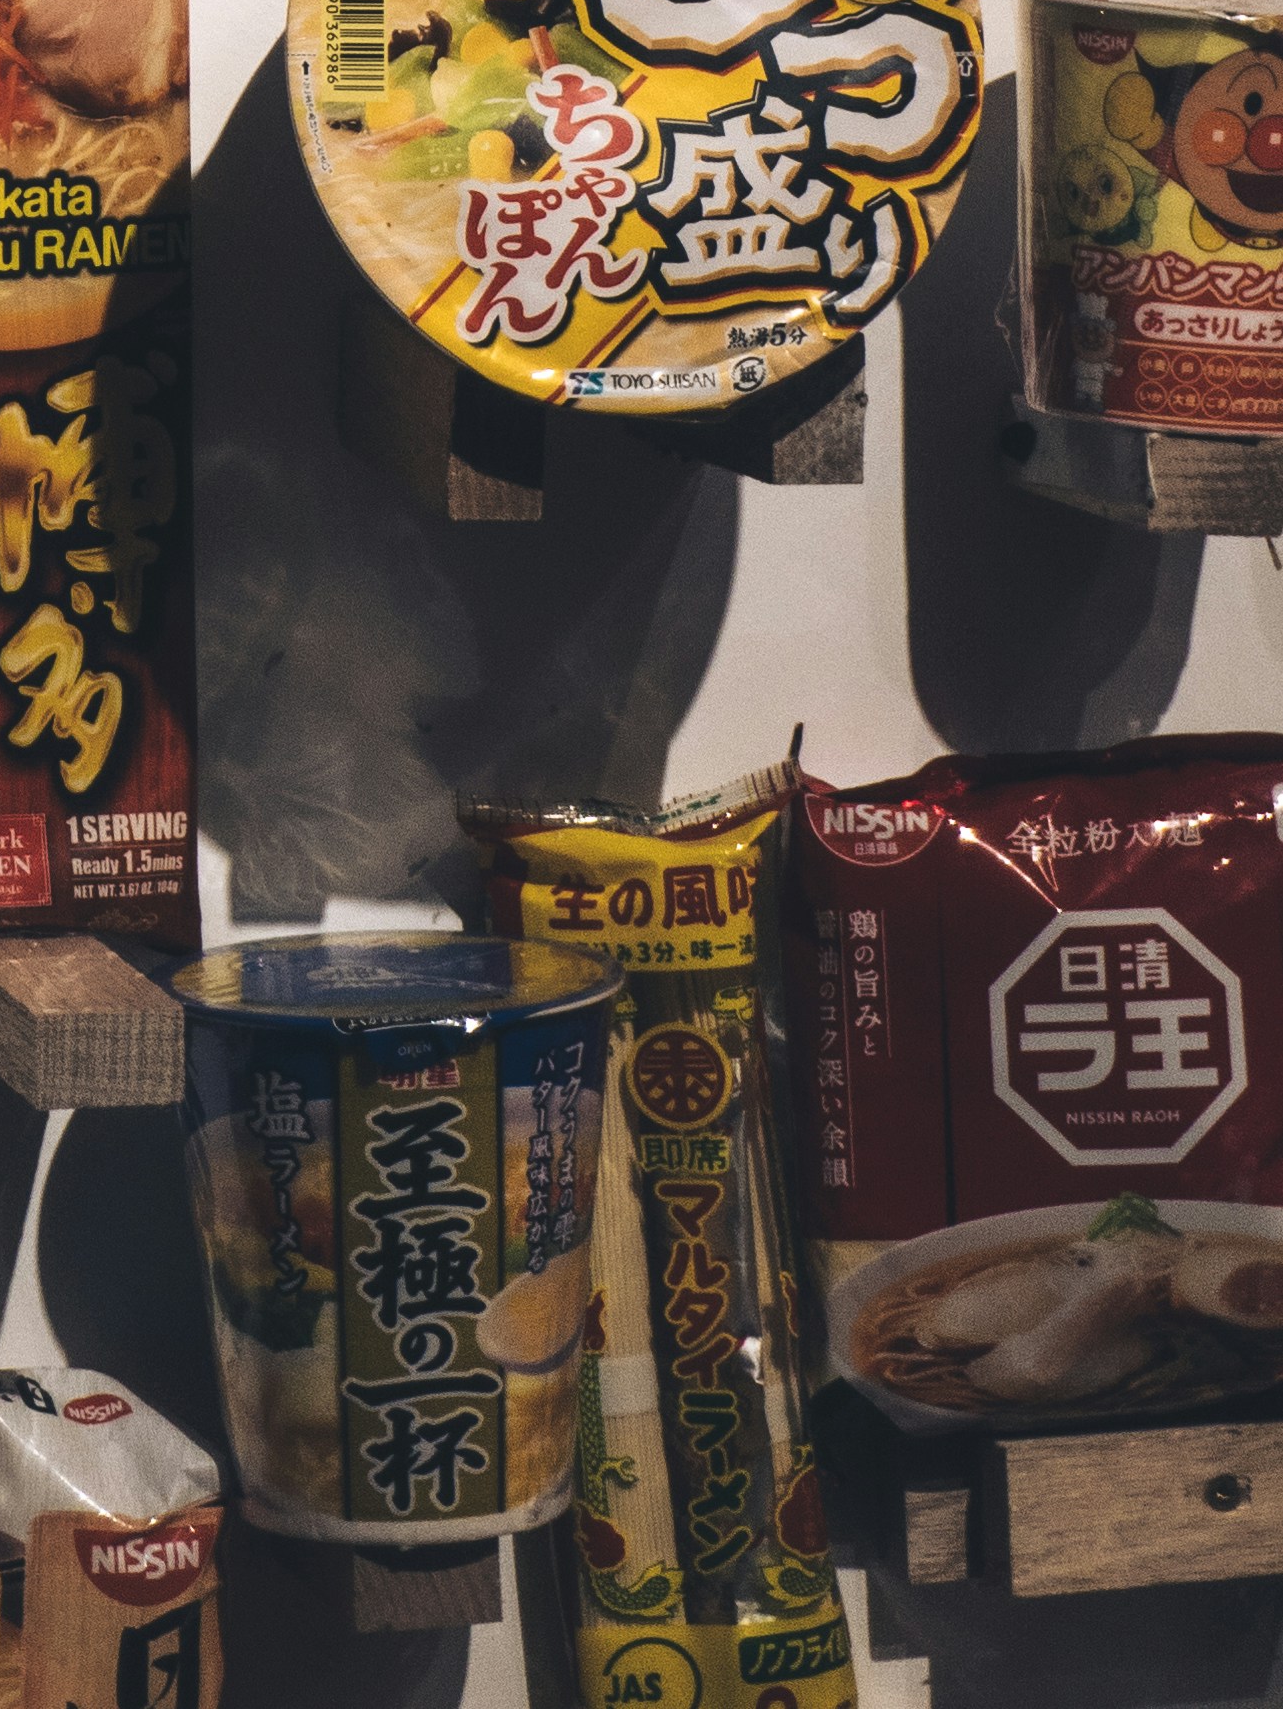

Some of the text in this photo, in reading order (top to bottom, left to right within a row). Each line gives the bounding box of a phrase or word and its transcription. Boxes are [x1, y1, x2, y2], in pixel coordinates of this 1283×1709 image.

[1076, 29, 1129, 52] NISSIN
[610, 369, 717, 392] TOYO SUISAN
[823, 803, 930, 840] NISSIN
[71, 857, 120, 876] Ready
[73, 884, 94, 899] NET
[1059, 940, 1171, 993] 日清
[1019, 997, 1221, 1092] ラ王
[1065, 1109, 1181, 1127] NISSIN RAOH
[343, 1096, 501, 1515] 至極の一杯
[66, 1399, 124, 1421] NISSIN
[90, 1537, 201, 1580] NISSIN
[605, 1672, 663, 1703] JAS
